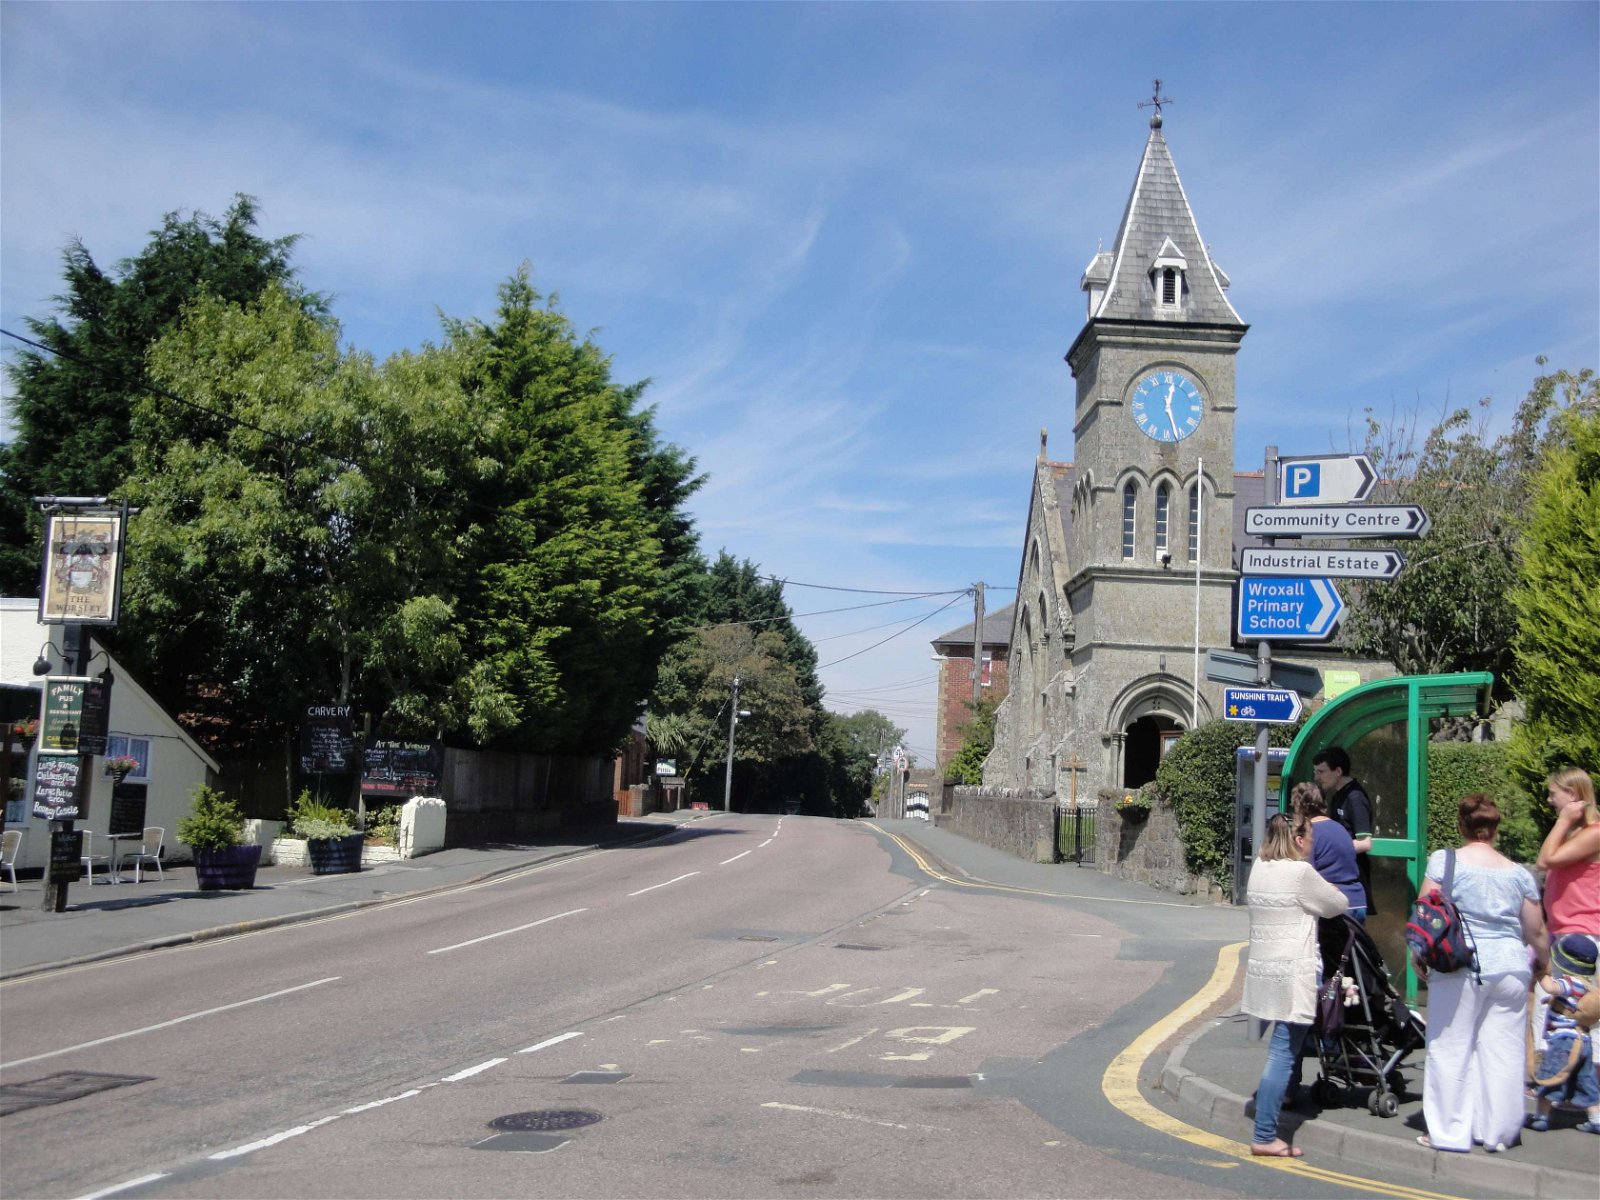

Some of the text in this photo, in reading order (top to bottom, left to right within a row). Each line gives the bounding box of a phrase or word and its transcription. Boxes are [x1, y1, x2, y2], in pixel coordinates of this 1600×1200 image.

[1293, 467, 1312, 495] P
[1252, 512, 1400, 528] Community Centre
[1249, 554, 1379, 570] Industrial Estate
[1248, 582, 1305, 597] Wroxall
[69, 595, 91, 603] THE
[56, 604, 101, 612] WORSLEY
[1248, 599, 1304, 615] Primary
[1249, 615, 1301, 629] School
[51, 684, 84, 696] FAMILY
[1230, 691, 1266, 701] SUNSHINE
[307, 705, 351, 717] CARVERY
